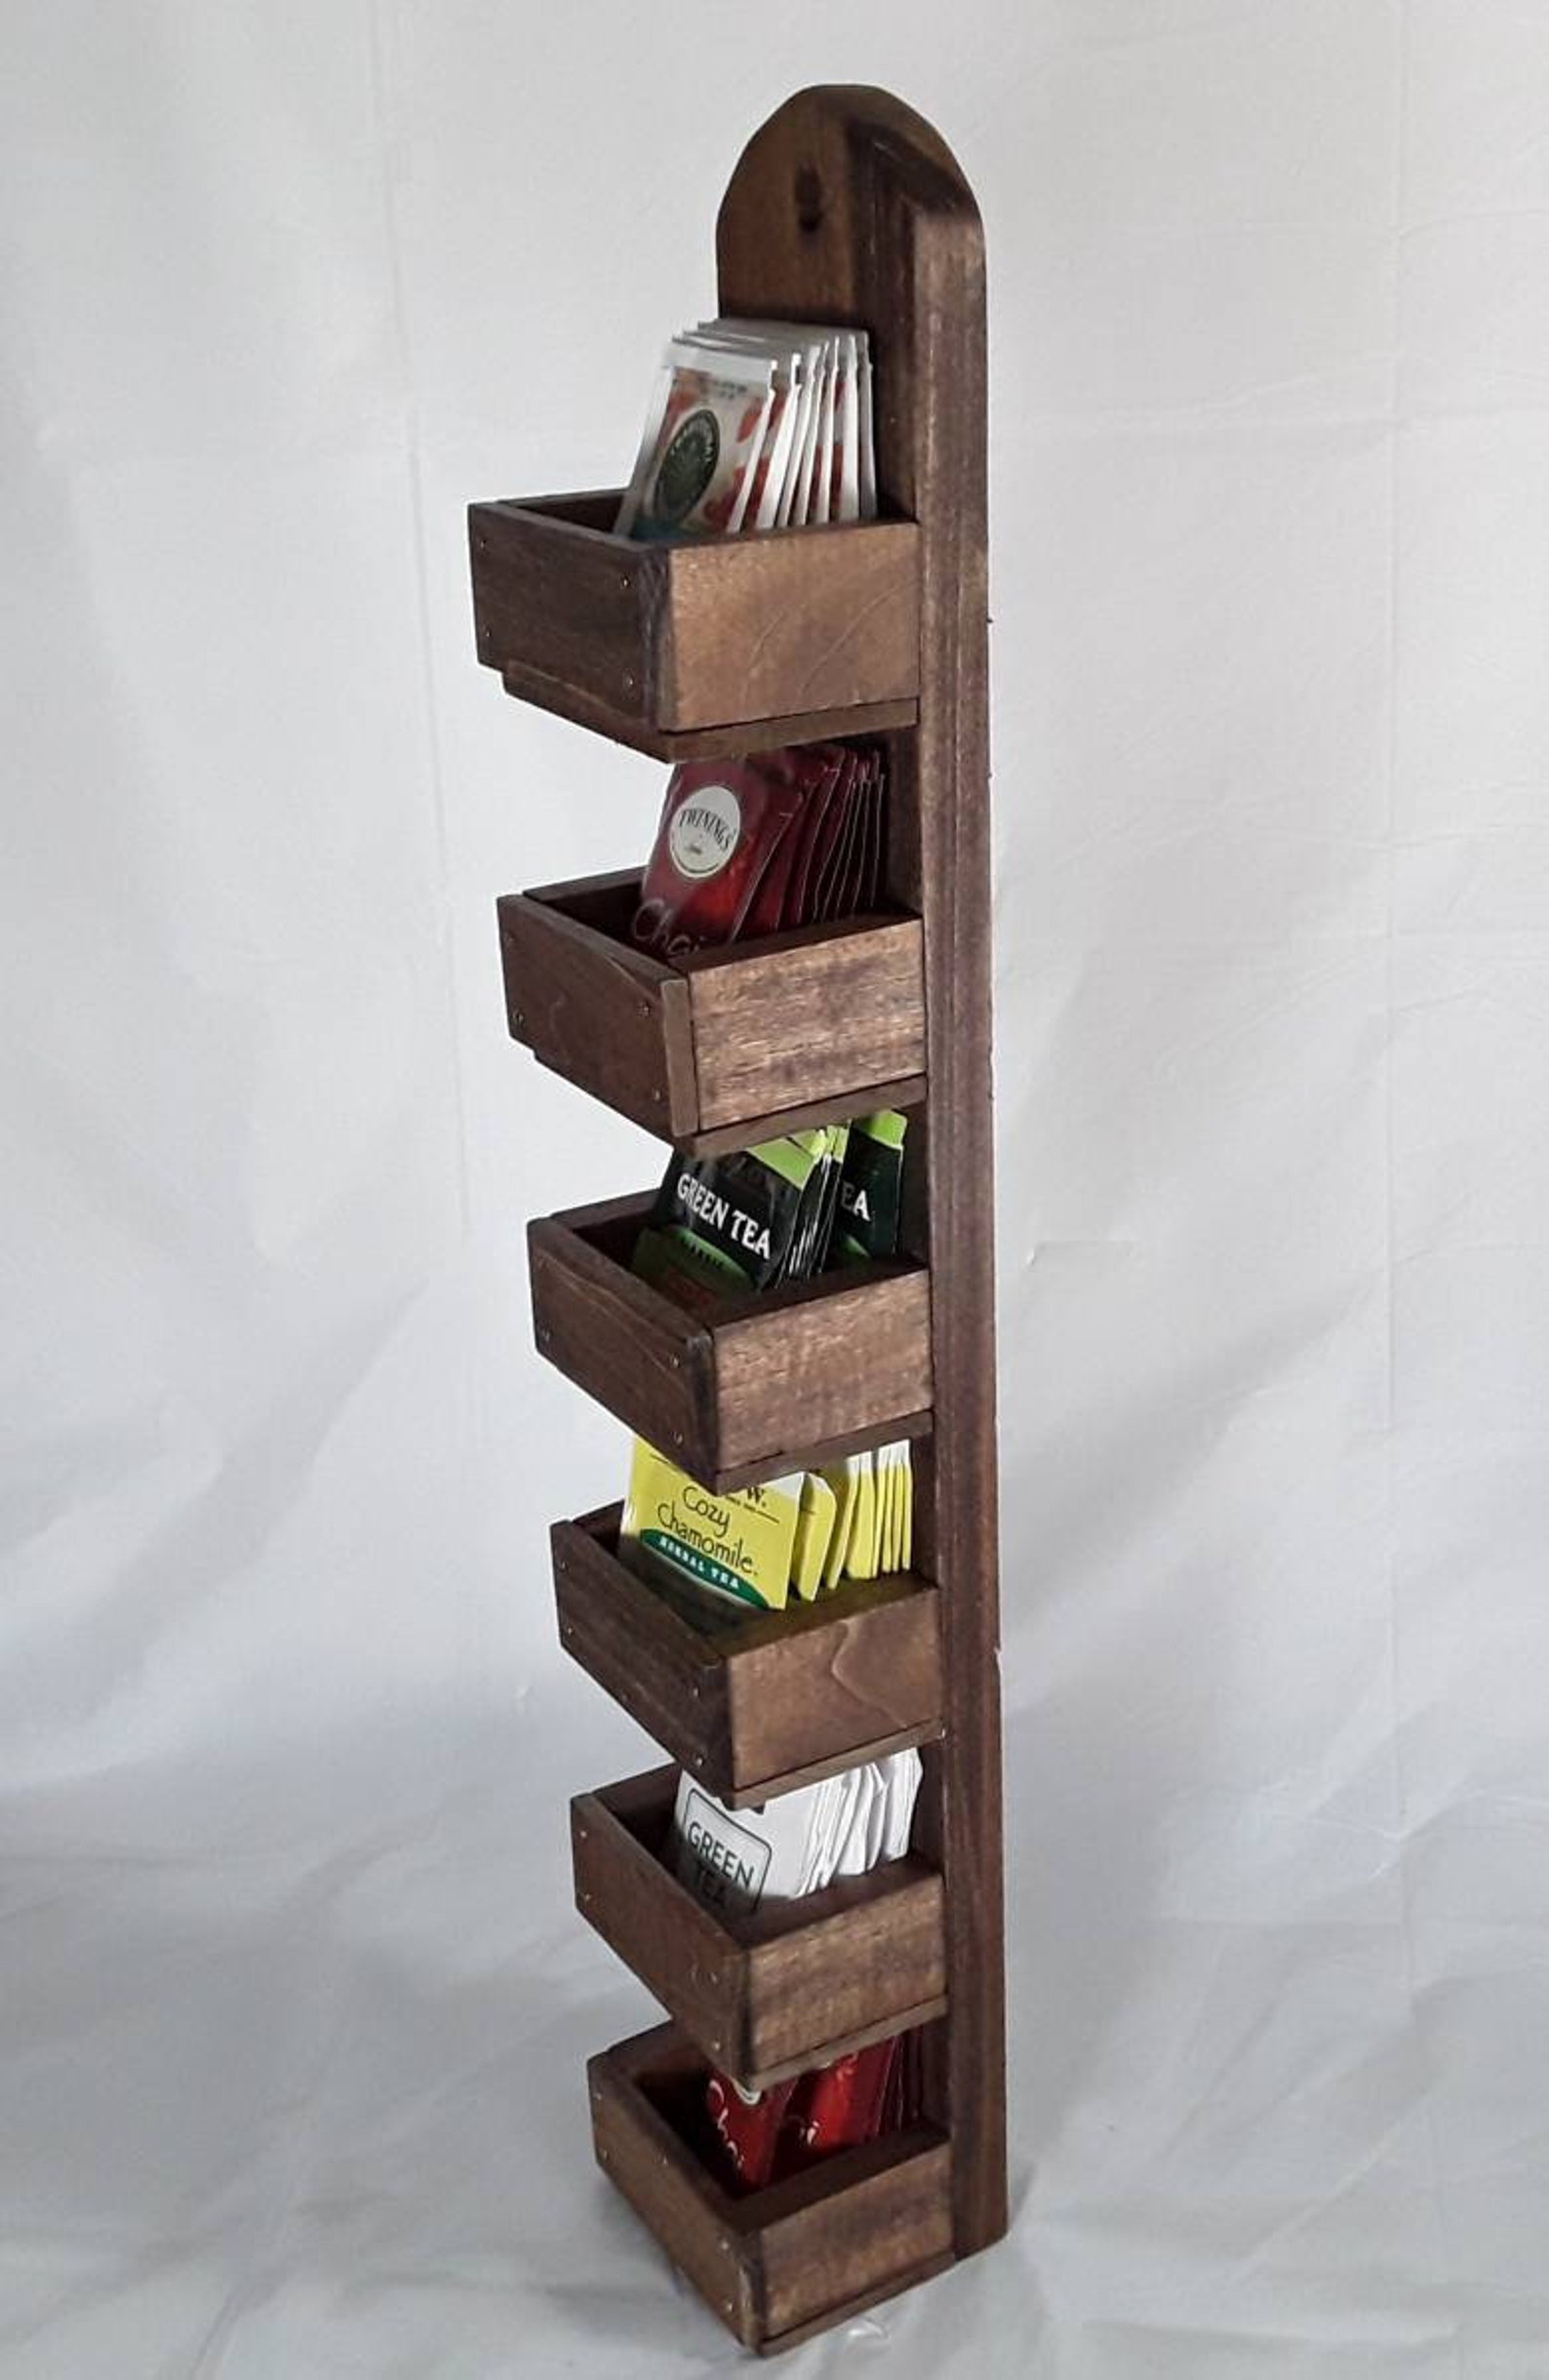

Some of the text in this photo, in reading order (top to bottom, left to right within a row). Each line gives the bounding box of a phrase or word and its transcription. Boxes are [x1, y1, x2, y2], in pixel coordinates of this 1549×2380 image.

[678, 809, 735, 852] TWININGS
[677, 1172, 731, 1231] GREEN
[730, 1210, 772, 1260] TEA
[840, 1180, 872, 1223] EA
[682, 1486, 732, 1539] Cozy
[658, 1535, 740, 1590] HERBAL TEA
[687, 1820, 756, 1888] GREEN
[692, 1859, 727, 1910] TEA
